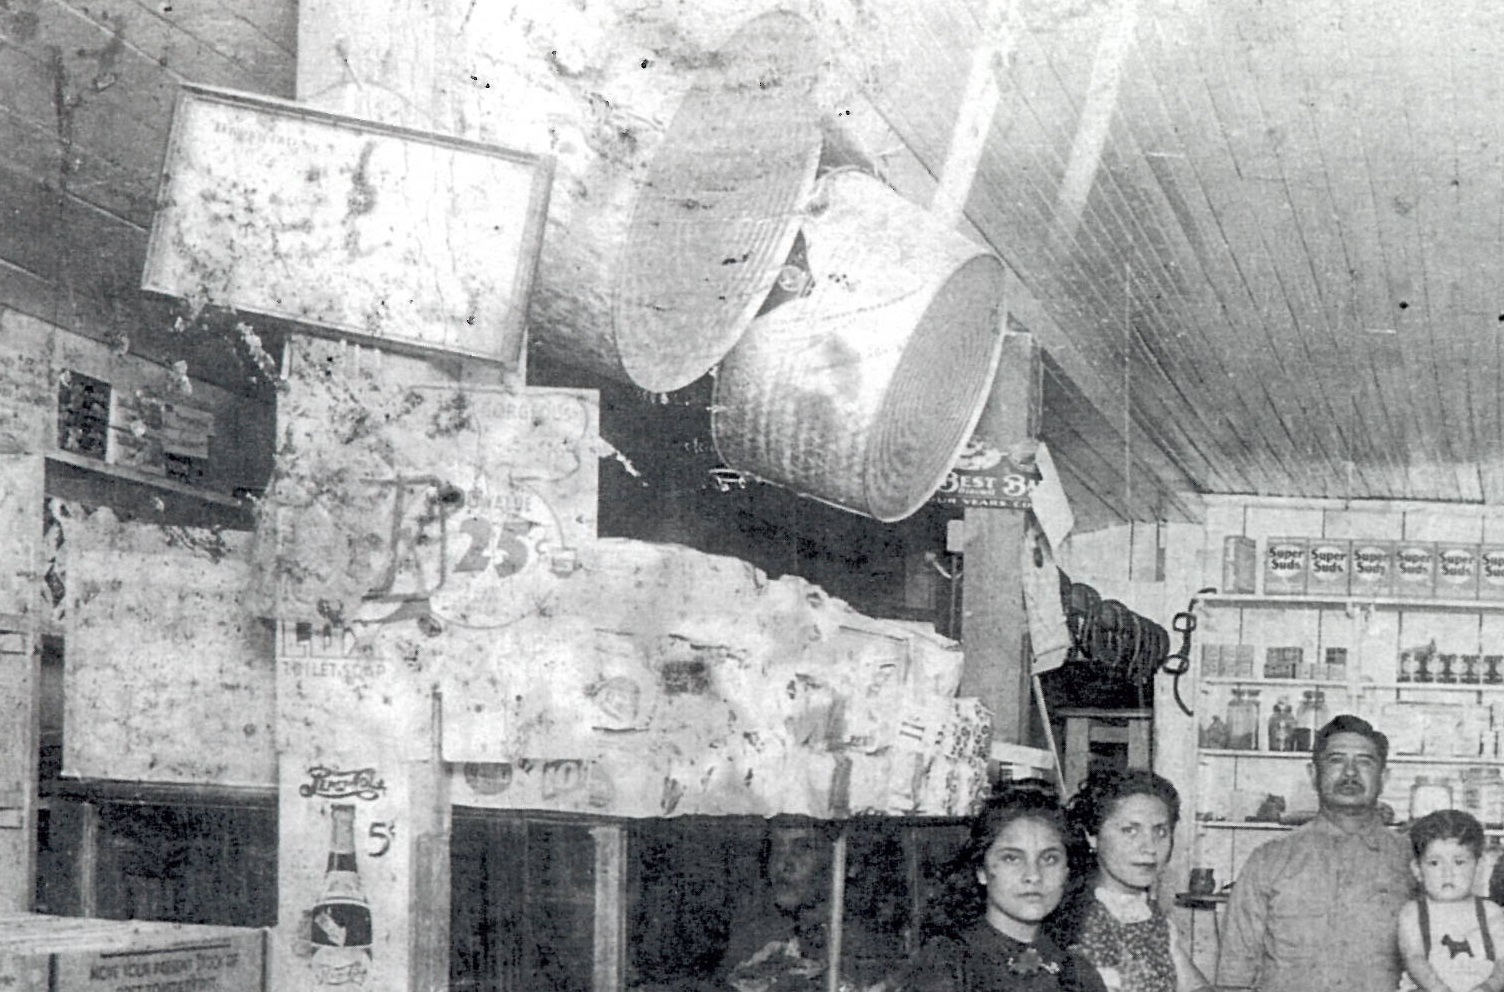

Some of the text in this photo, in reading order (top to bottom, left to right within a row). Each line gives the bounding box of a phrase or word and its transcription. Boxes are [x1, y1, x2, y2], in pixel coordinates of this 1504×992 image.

[962, 498, 1007, 507] YEARS
[1269, 546, 1304, 561] Super
[1311, 548, 1346, 563] Super
[1439, 551, 1474, 566] Super
[1270, 558, 1302, 571] Suds
[1313, 560, 1344, 574] Suds
[1442, 564, 1471, 577] Suds
